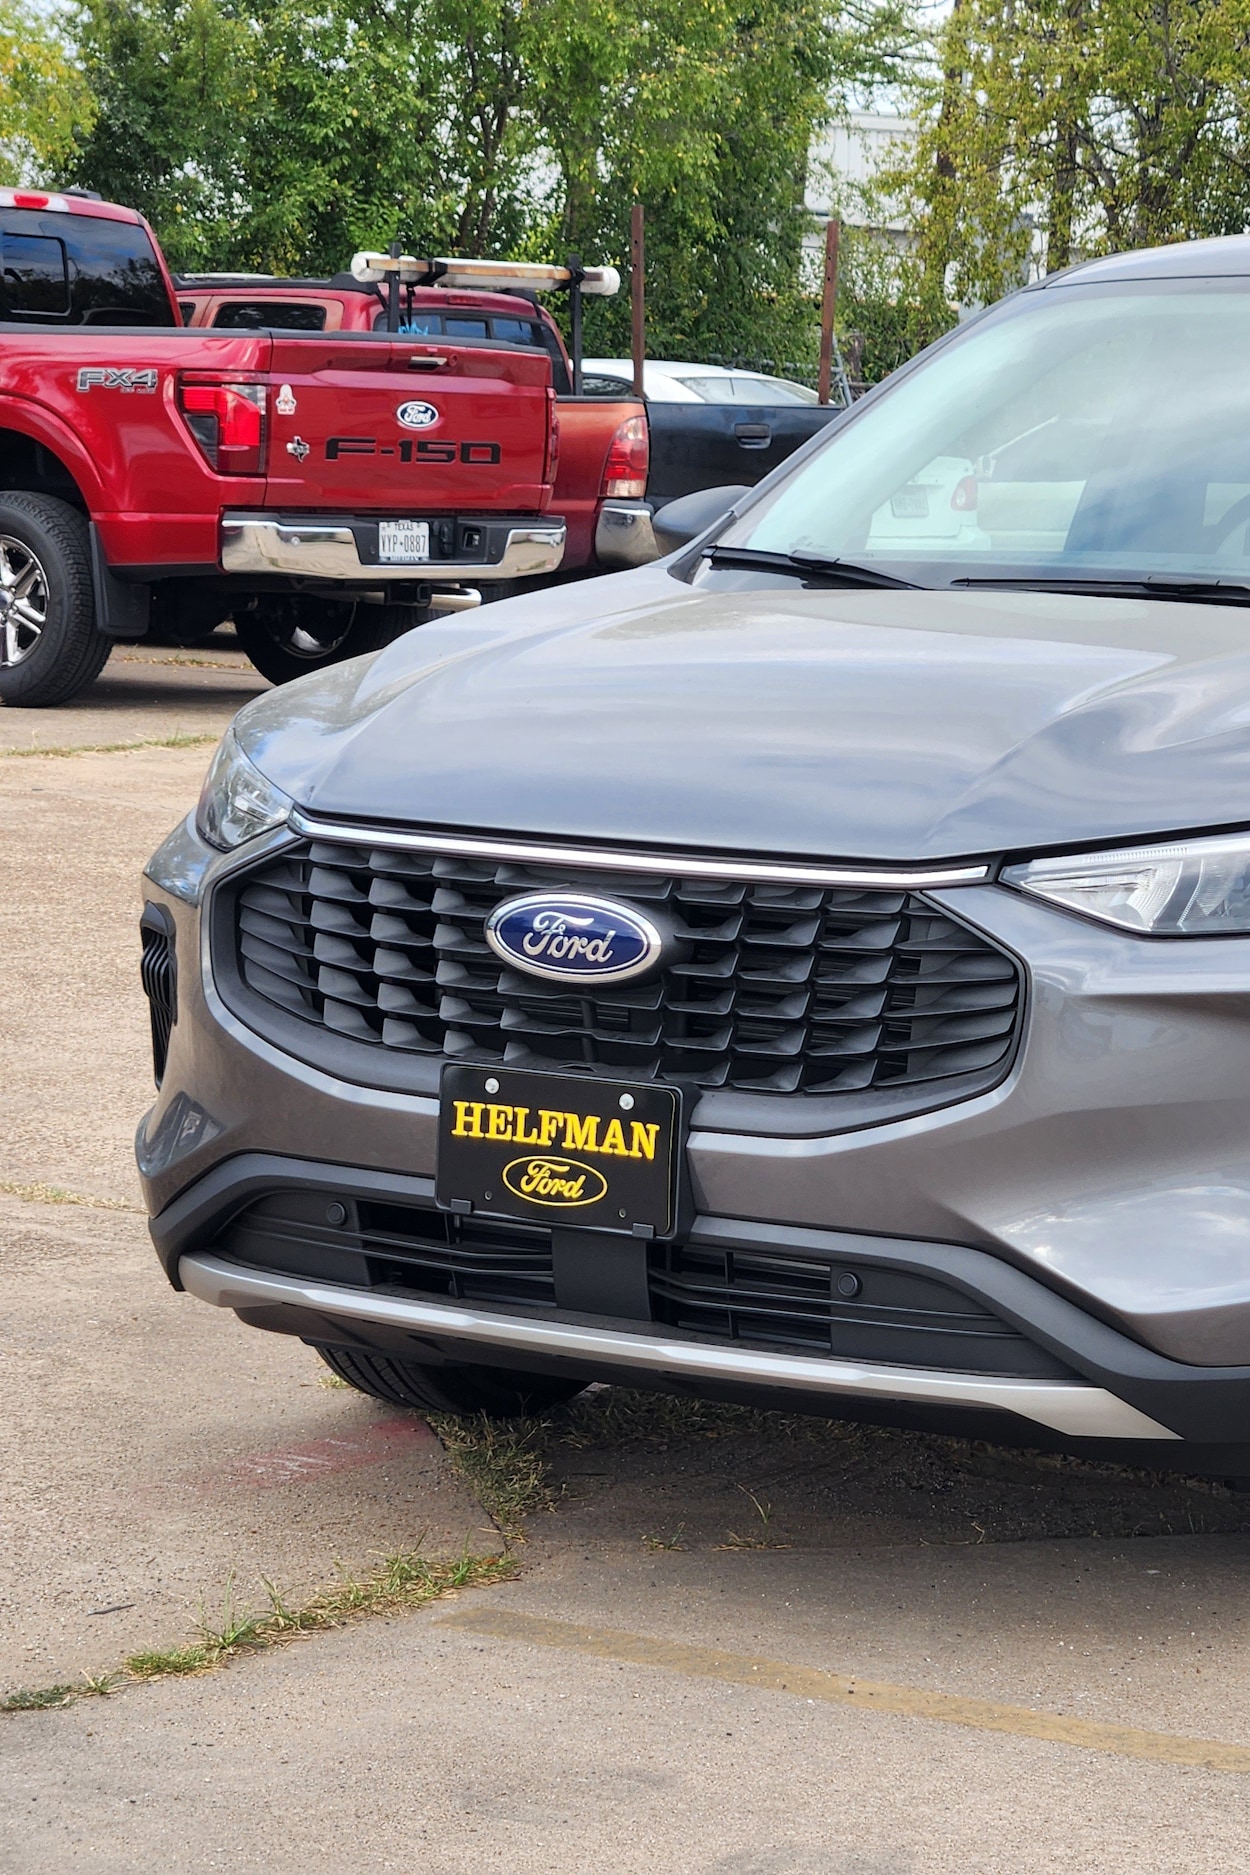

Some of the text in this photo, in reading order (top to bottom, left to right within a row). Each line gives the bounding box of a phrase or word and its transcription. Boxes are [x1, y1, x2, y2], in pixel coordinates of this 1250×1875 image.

[77, 366, 158, 392] FX4
[403, 404, 433, 424] Ford
[325, 436, 501, 465] F-150
[521, 910, 617, 963] Ford
[451, 1100, 661, 1160] HELFMAN
[520, 1159, 587, 1199] Ford
